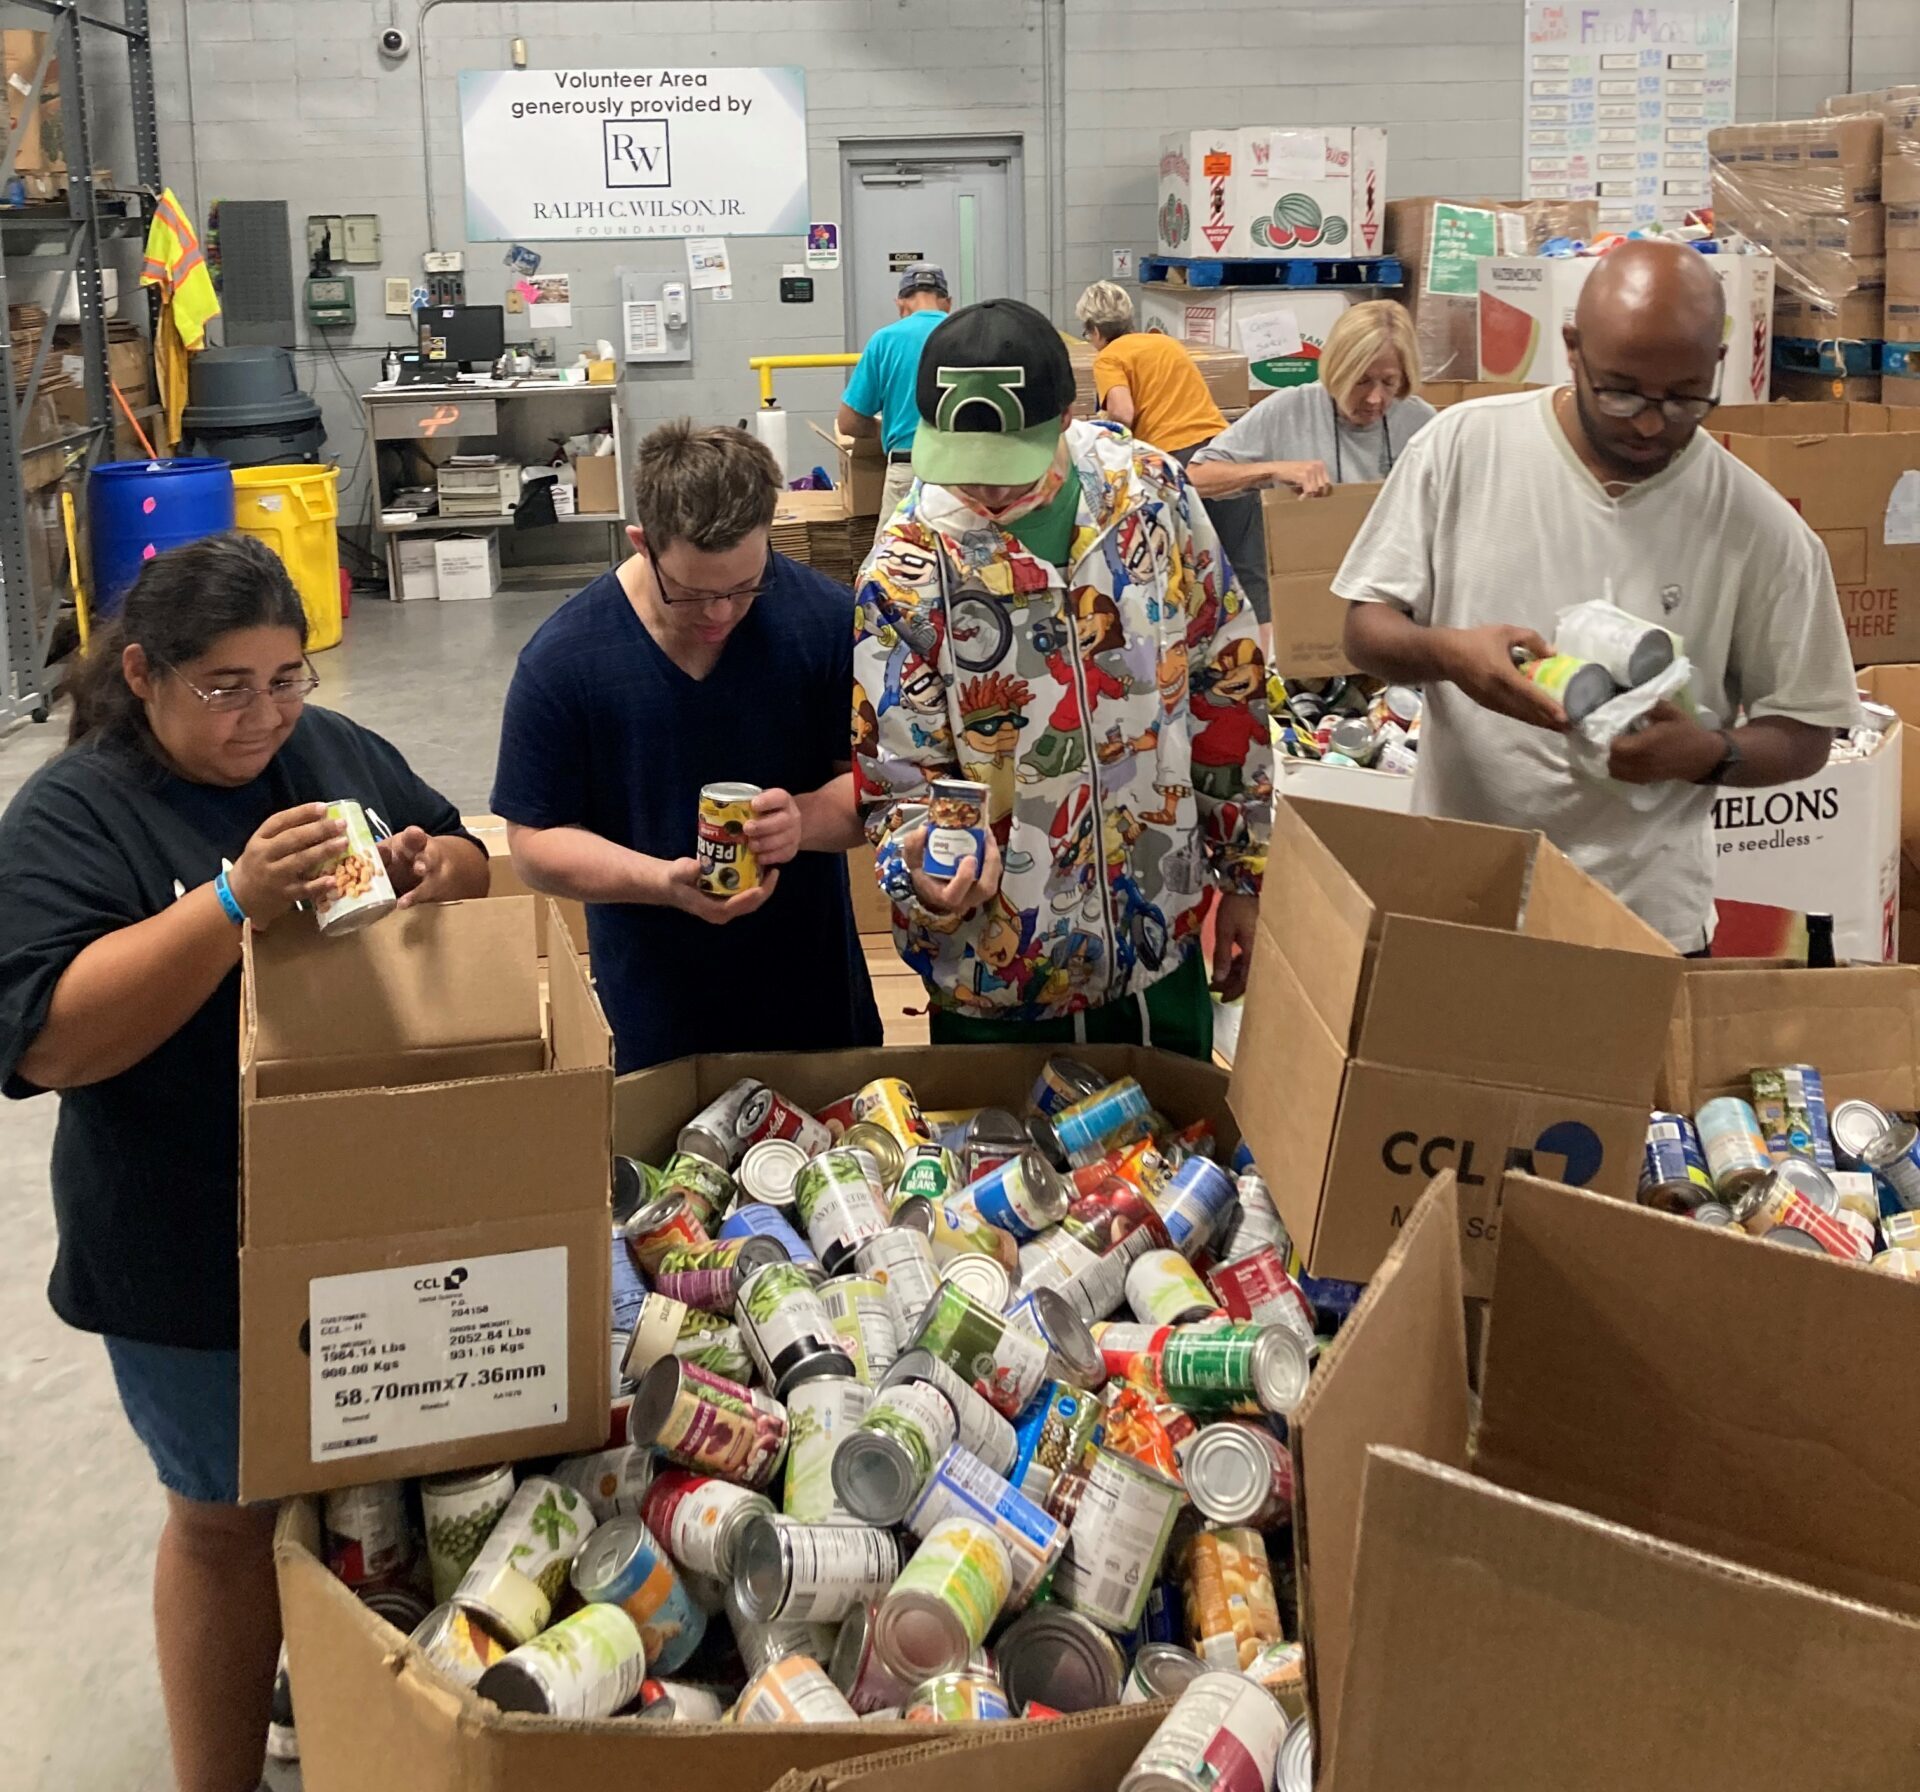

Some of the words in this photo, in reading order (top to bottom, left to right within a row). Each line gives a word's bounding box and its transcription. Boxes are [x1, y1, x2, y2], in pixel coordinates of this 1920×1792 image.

[554, 72, 653, 89] Volunteer
[659, 71, 708, 87] Area
[511, 97, 623, 118] generously
[630, 96, 721, 117] provided
[727, 96, 752, 115] by
[533, 201, 604, 219] RALPH
[608, 201, 628, 217] C.
[717, 199, 745, 217] JR.
[575, 225, 706, 236] FOUNDATION
[895, 253, 918, 261] Office
[1848, 588, 1898, 612] TOTE
[1846, 614, 1897, 638] HERE
[1716, 842, 1733, 858] e
[1738, 828, 1811, 852] seedless
[1382, 1131, 1485, 1186] CCL
[911, 1169, 935, 1181] LIMA
[906, 1180, 936, 1192] BEANS
[413, 1278, 441, 1291] CCL
[450, 1330, 503, 1346] 2052.84
[508, 1327, 531, 1338] Lbs
[323, 1346, 376, 1362] 1984.14
[381, 1342, 406, 1354] Lbs
[450, 1345, 495, 1360] 931.16
[500, 1342, 525, 1353] Kgs
[374, 1360, 399, 1372] Kgs
[334, 1363, 546, 1408] 58.70mmx7.36mm
[552, 1403, 558, 1414] 1
